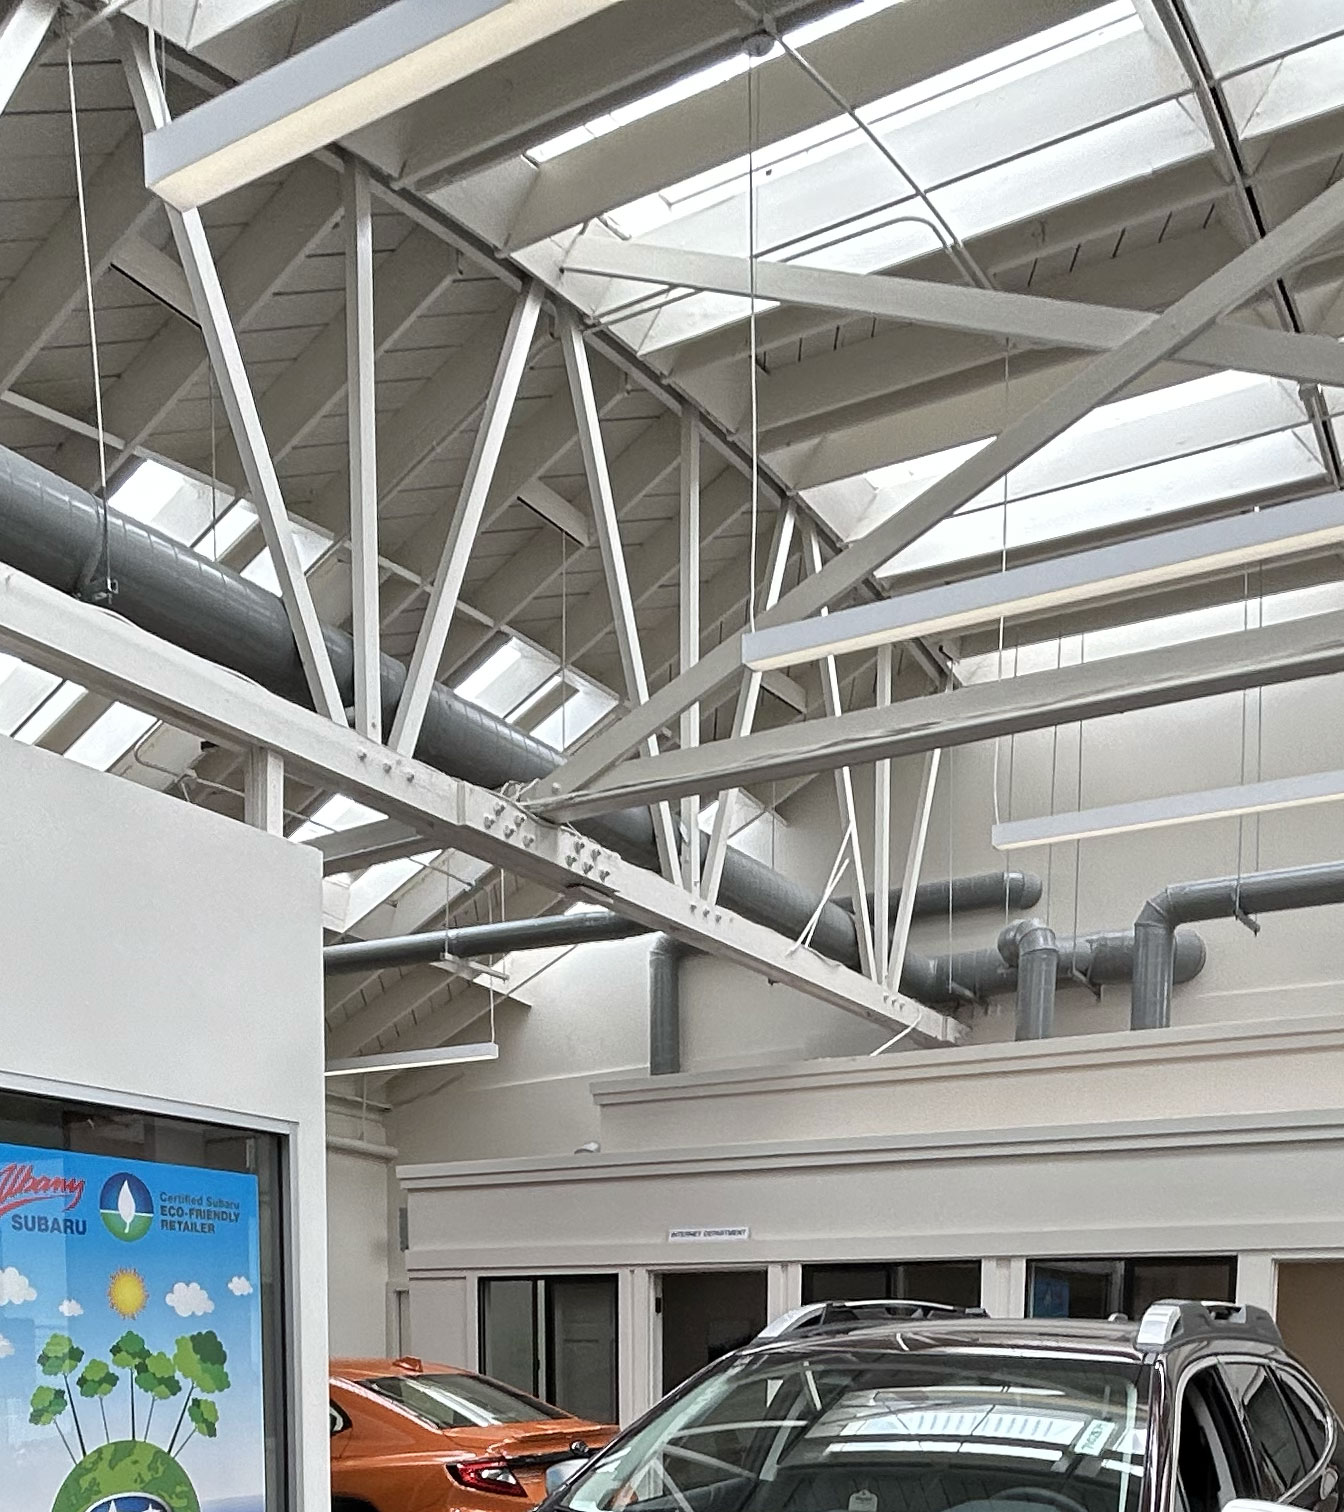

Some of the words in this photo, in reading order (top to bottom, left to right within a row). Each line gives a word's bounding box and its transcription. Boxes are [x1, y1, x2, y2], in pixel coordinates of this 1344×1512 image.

[159, 1192, 203, 1206] Certified
[159, 1205, 240, 1223] ECO-FRIENDLY
[11, 1214, 87, 1235] SUBARU
[160, 1219, 215, 1234] RETAILER
